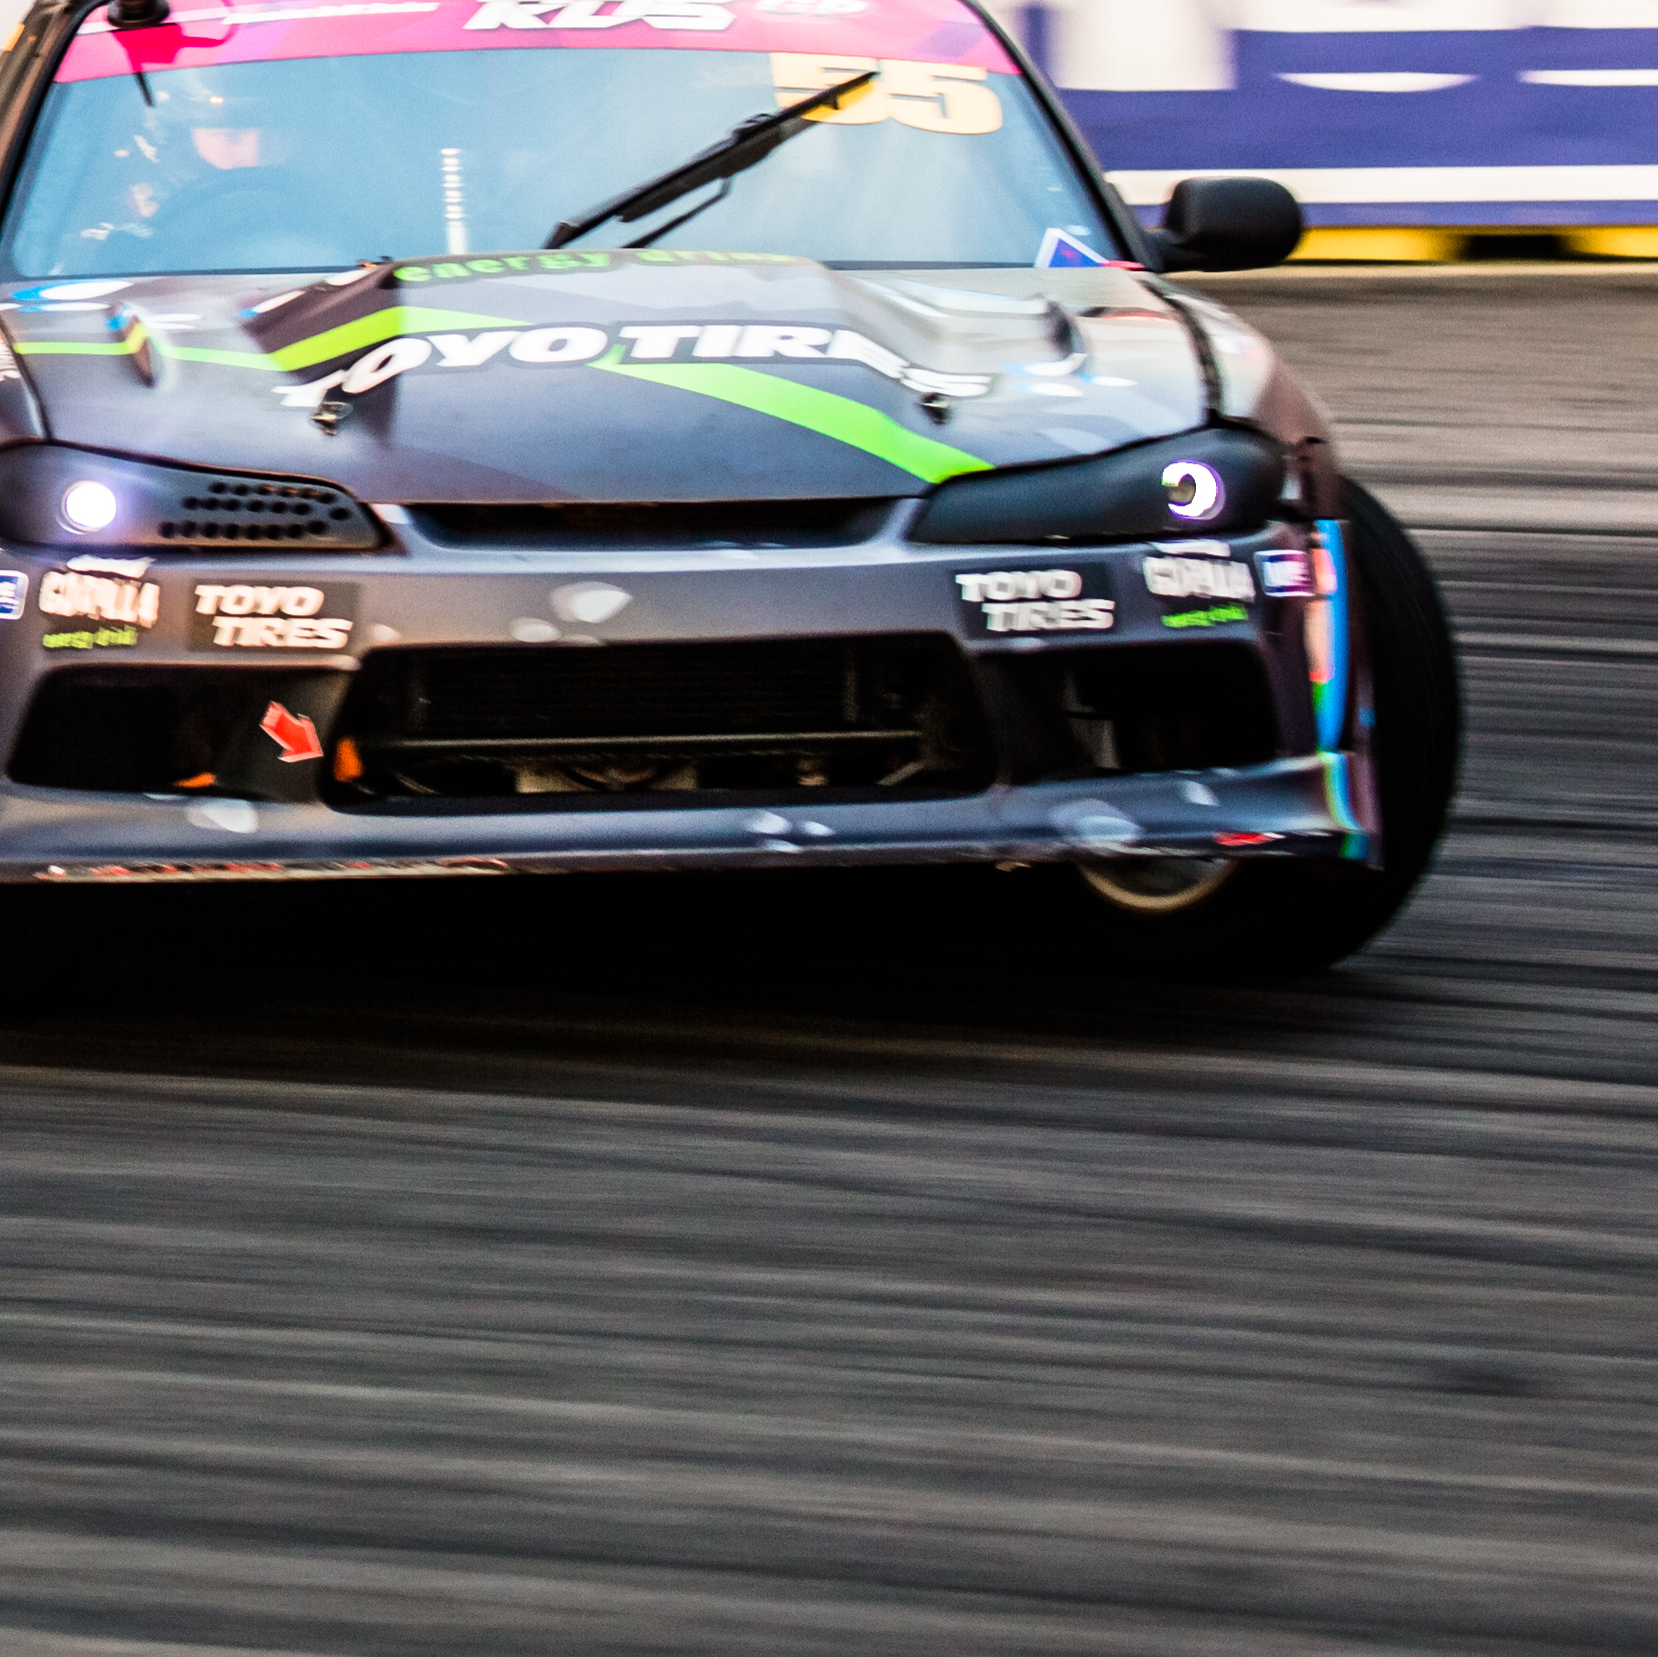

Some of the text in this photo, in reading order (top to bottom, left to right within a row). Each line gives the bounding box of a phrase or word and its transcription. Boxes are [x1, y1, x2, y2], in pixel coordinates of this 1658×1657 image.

[770, 52, 1003, 135] 55
[272, 324, 991, 408] TOYO TIRES
[194, 584, 325, 617] TOYO
[954, 569, 1083, 602] TOYO
[211, 615, 354, 649] TIRES
[981, 599, 1116, 632] TIRES
